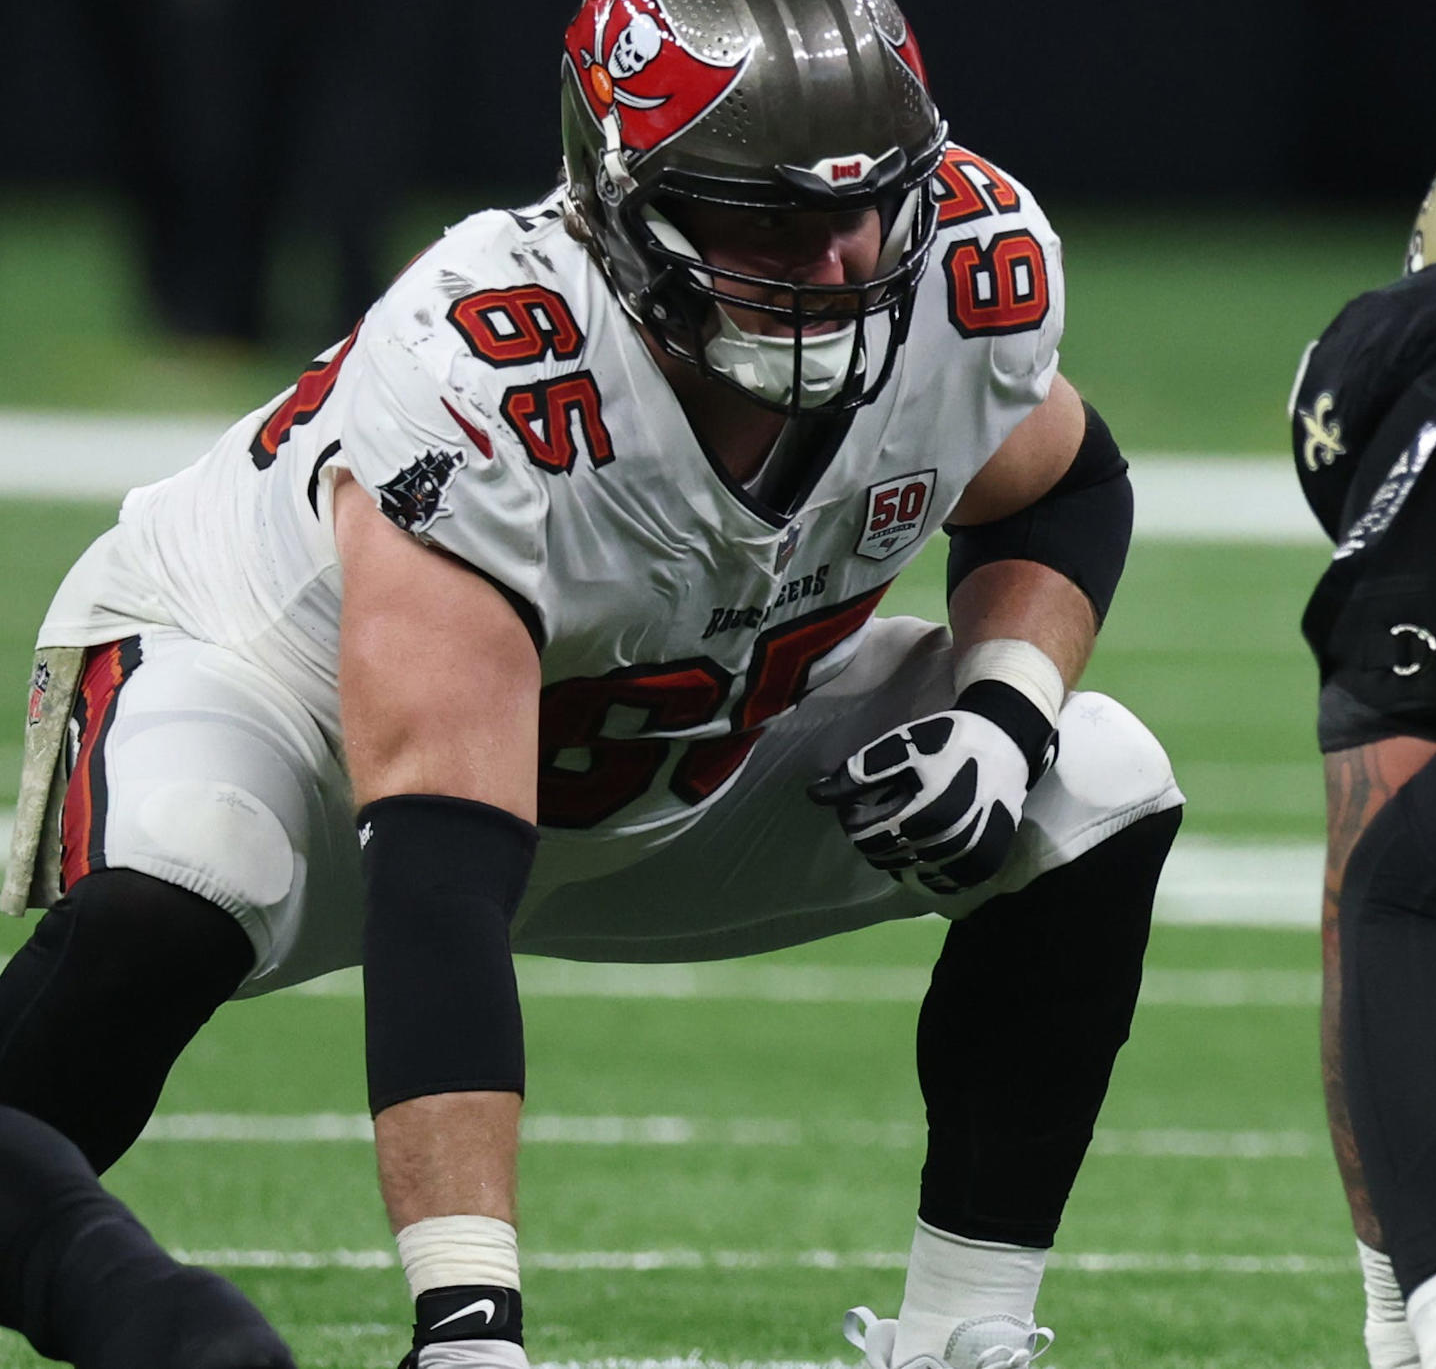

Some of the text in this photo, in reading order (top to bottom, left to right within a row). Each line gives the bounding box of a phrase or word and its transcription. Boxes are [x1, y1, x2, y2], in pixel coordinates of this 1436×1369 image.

[932, 147, 1050, 340] 65
[446, 283, 617, 477] 65
[869, 481, 928, 532] 50
